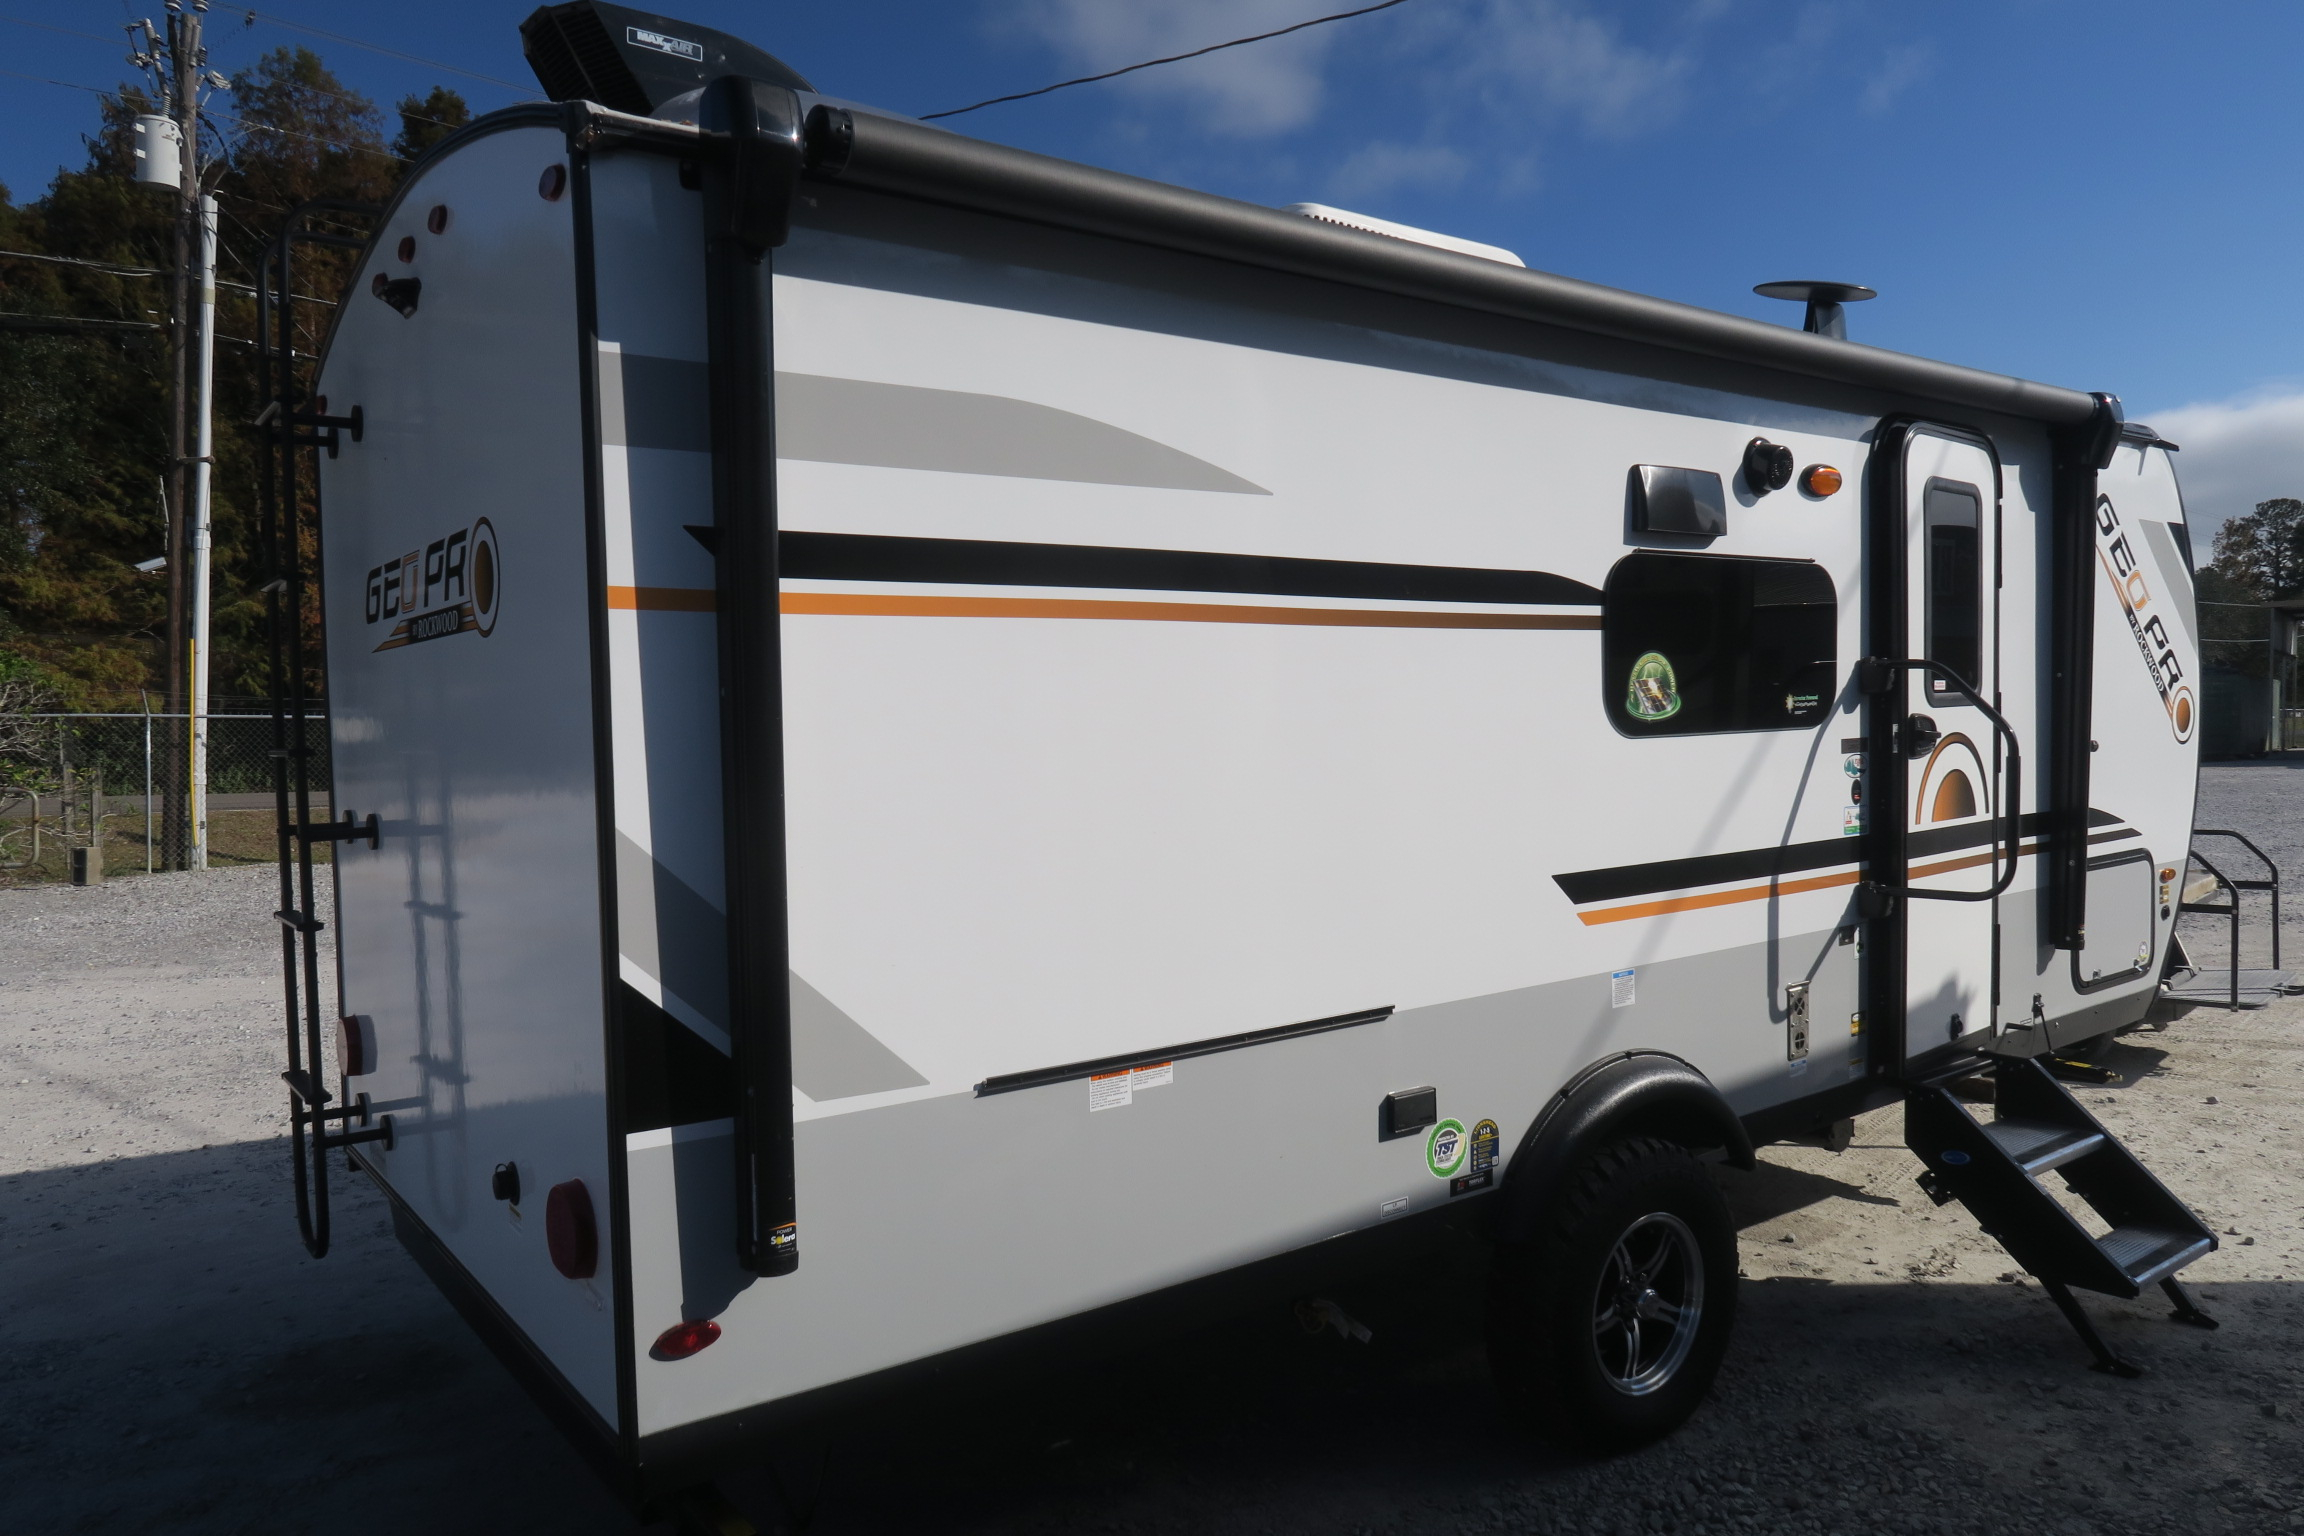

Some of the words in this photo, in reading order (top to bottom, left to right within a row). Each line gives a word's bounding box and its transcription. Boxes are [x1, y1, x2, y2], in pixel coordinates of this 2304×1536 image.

[2096, 492, 2151, 612] GEO
[365, 549, 420, 625] GEO
[418, 610, 459, 639] ROCKWOOD
[2132, 622, 2165, 693] ROCKWOOD
[1437, 1140, 1459, 1156] TST
[771, 1233, 795, 1245] Solera
